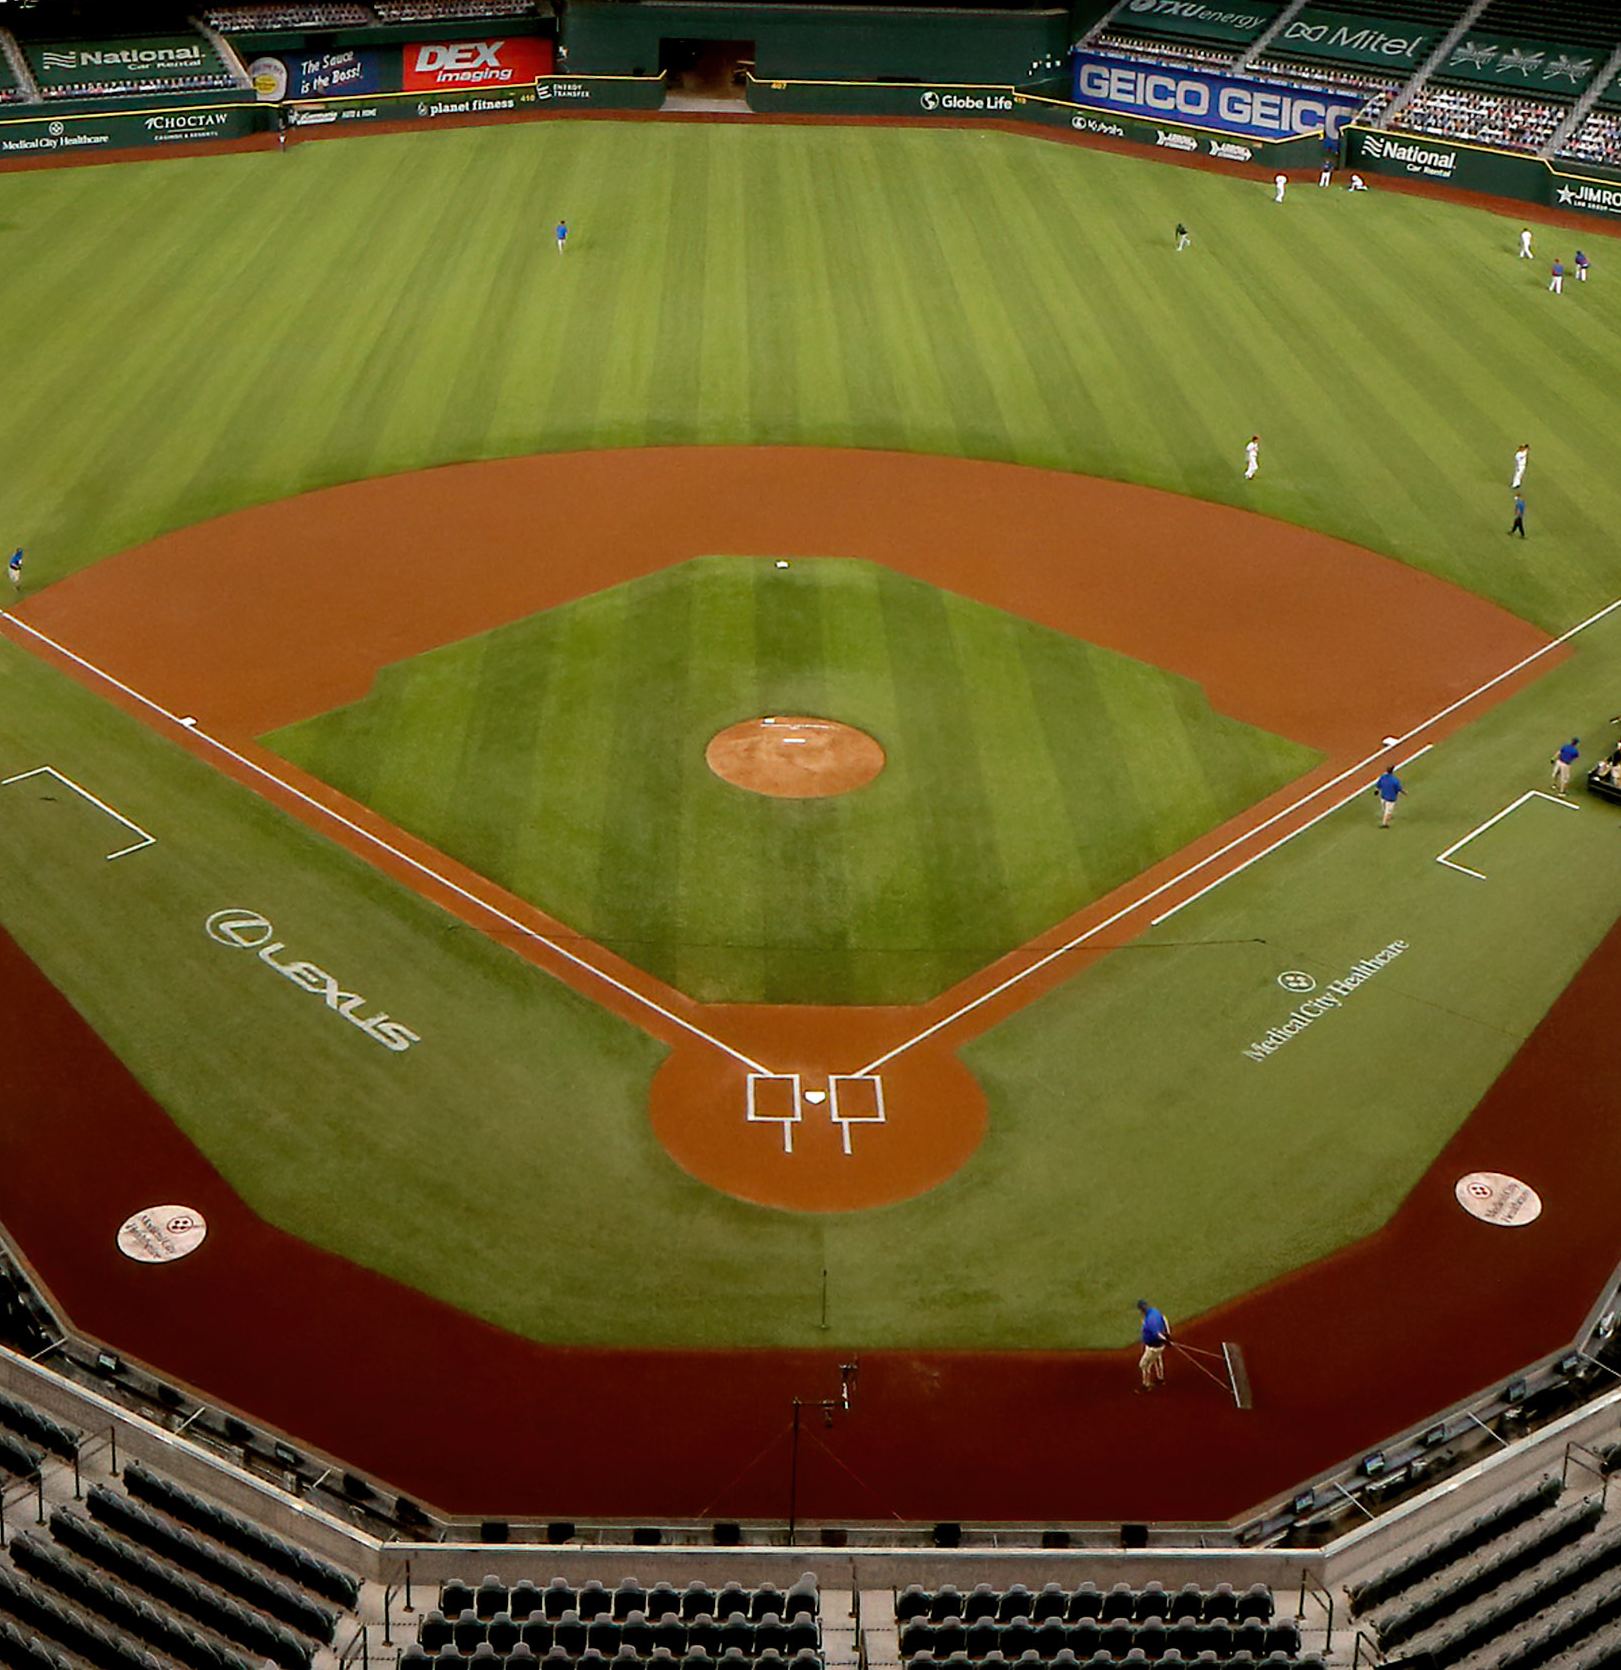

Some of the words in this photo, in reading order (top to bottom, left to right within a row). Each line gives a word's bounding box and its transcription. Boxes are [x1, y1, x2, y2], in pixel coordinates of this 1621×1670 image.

[414, 40, 506, 73] DEX
[1328, 26, 1424, 58] Mitel
[301, 59, 321, 77] The
[322, 50, 355, 69] Sauce
[313, 74, 331, 93] the
[331, 62, 363, 85] Boss!
[436, 67, 513, 84] imaging
[941, 94, 984, 110] Globe
[986, 95, 1013, 110] Life
[1079, 62, 1211, 117] GEICO
[153, 113, 229, 130] CHOCTAW
[430, 100, 470, 117] planet
[472, 97, 515, 112] fitness
[2, 138, 39, 152] Medical
[39, 137, 59, 150] City
[59, 133, 110, 147] Healthcare
[257, 941, 422, 1052] LEXUS
[1242, 1011, 1314, 1063] Medical
[1299, 991, 1344, 1019] City
[1326, 938, 1410, 998] Healthcare
